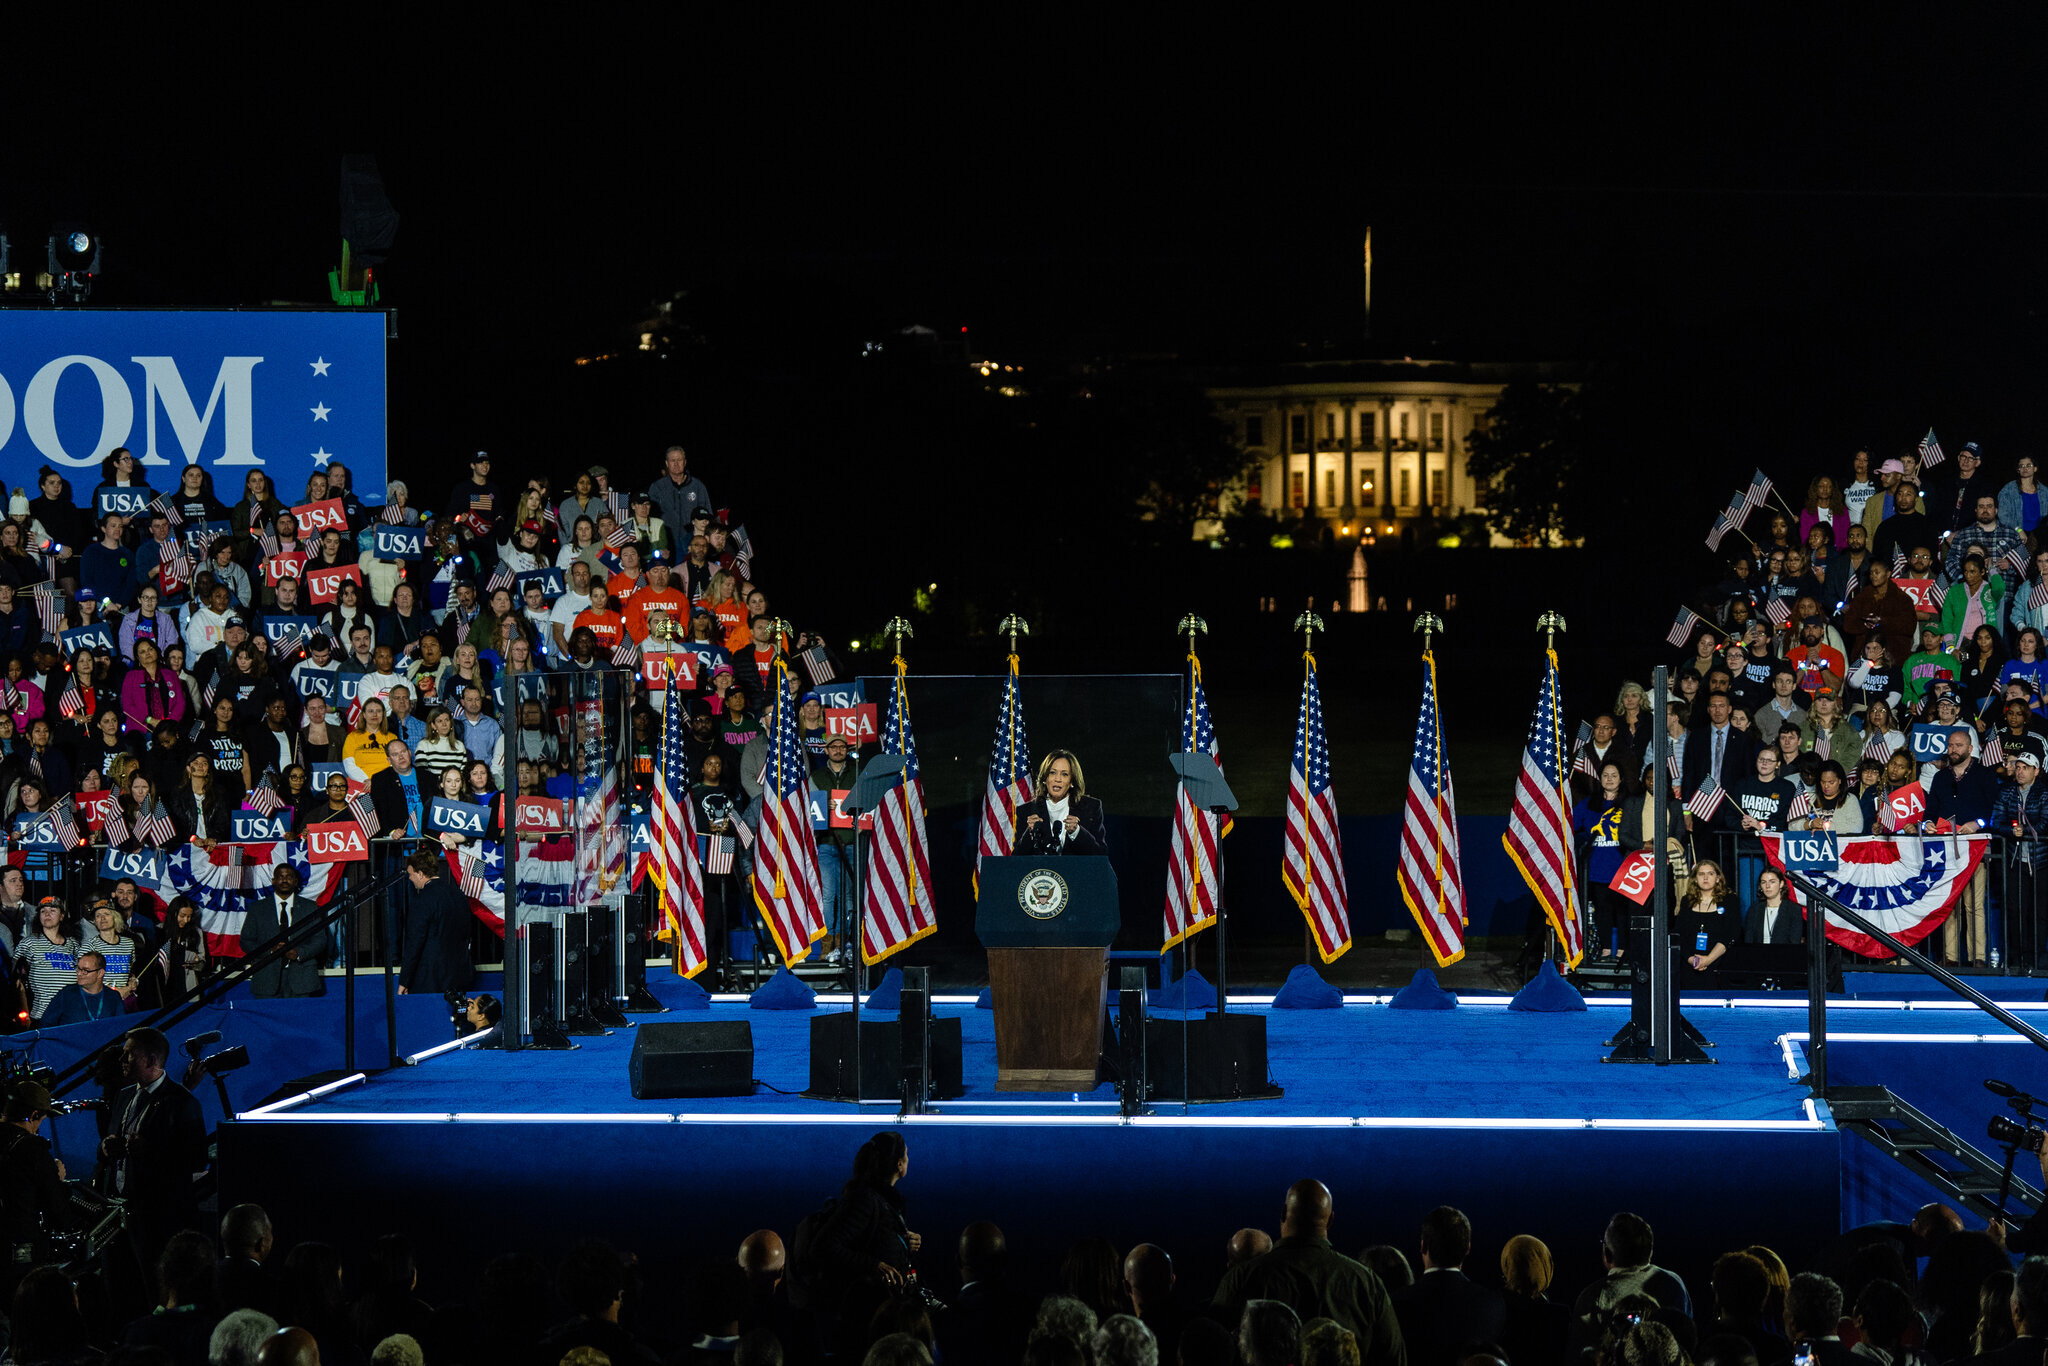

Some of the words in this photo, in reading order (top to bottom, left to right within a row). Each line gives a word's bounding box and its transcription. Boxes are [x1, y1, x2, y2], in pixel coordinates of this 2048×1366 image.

[0, 355, 265, 467] OM
[101, 494, 148, 512] USA
[296, 507, 344, 531] USA
[468, 513, 492, 534] US
[377, 532, 421, 554] USA
[1900, 585, 1934, 607] SA
[64, 631, 113, 654] USA
[692, 650, 726, 670] SA
[1746, 664, 1771, 677] ARRIS
[828, 713, 875, 737] USA
[1914, 732, 1948, 754] US
[2017, 751, 2032, 760] SA
[78, 800, 110, 822] US
[1741, 794, 1780, 814] HARRIS
[1747, 809, 1772, 820] WALZ
[1892, 793, 1925, 819] SA
[234, 818, 285, 839] USA
[433, 806, 484, 832] USA
[310, 830, 365, 854] USA
[1785, 840, 1836, 862] USA
[108, 848, 158, 880] USA
[1618, 852, 1655, 894] USA
